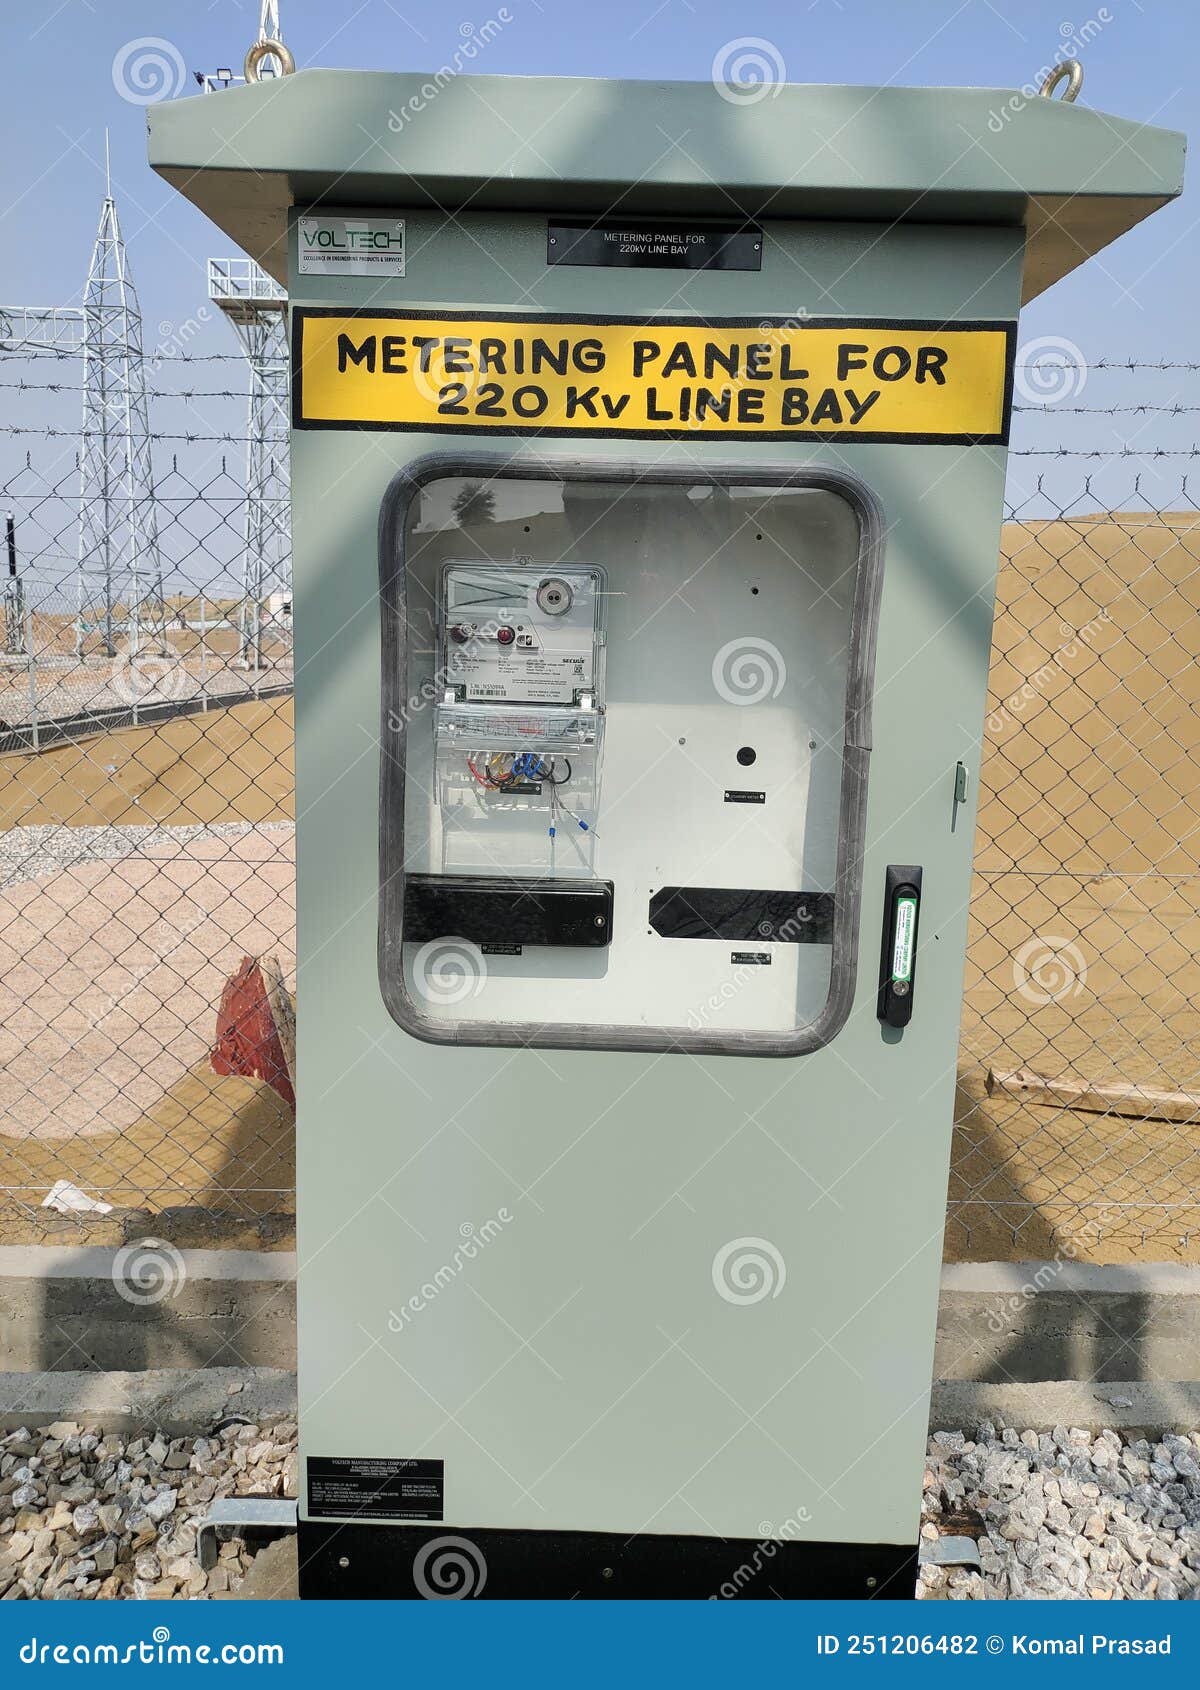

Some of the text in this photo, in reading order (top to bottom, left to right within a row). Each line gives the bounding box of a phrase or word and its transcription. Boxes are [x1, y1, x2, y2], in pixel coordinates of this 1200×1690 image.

[303, 230, 402, 249] VOLTECH
[604, 233, 706, 244] METERING PANEL FOR
[620, 244, 689, 254] 220kV LINE BAY
[337, 333, 948, 385] METERING PANEL FOR
[437, 383, 881, 425] 220 Kv LINE BAY
